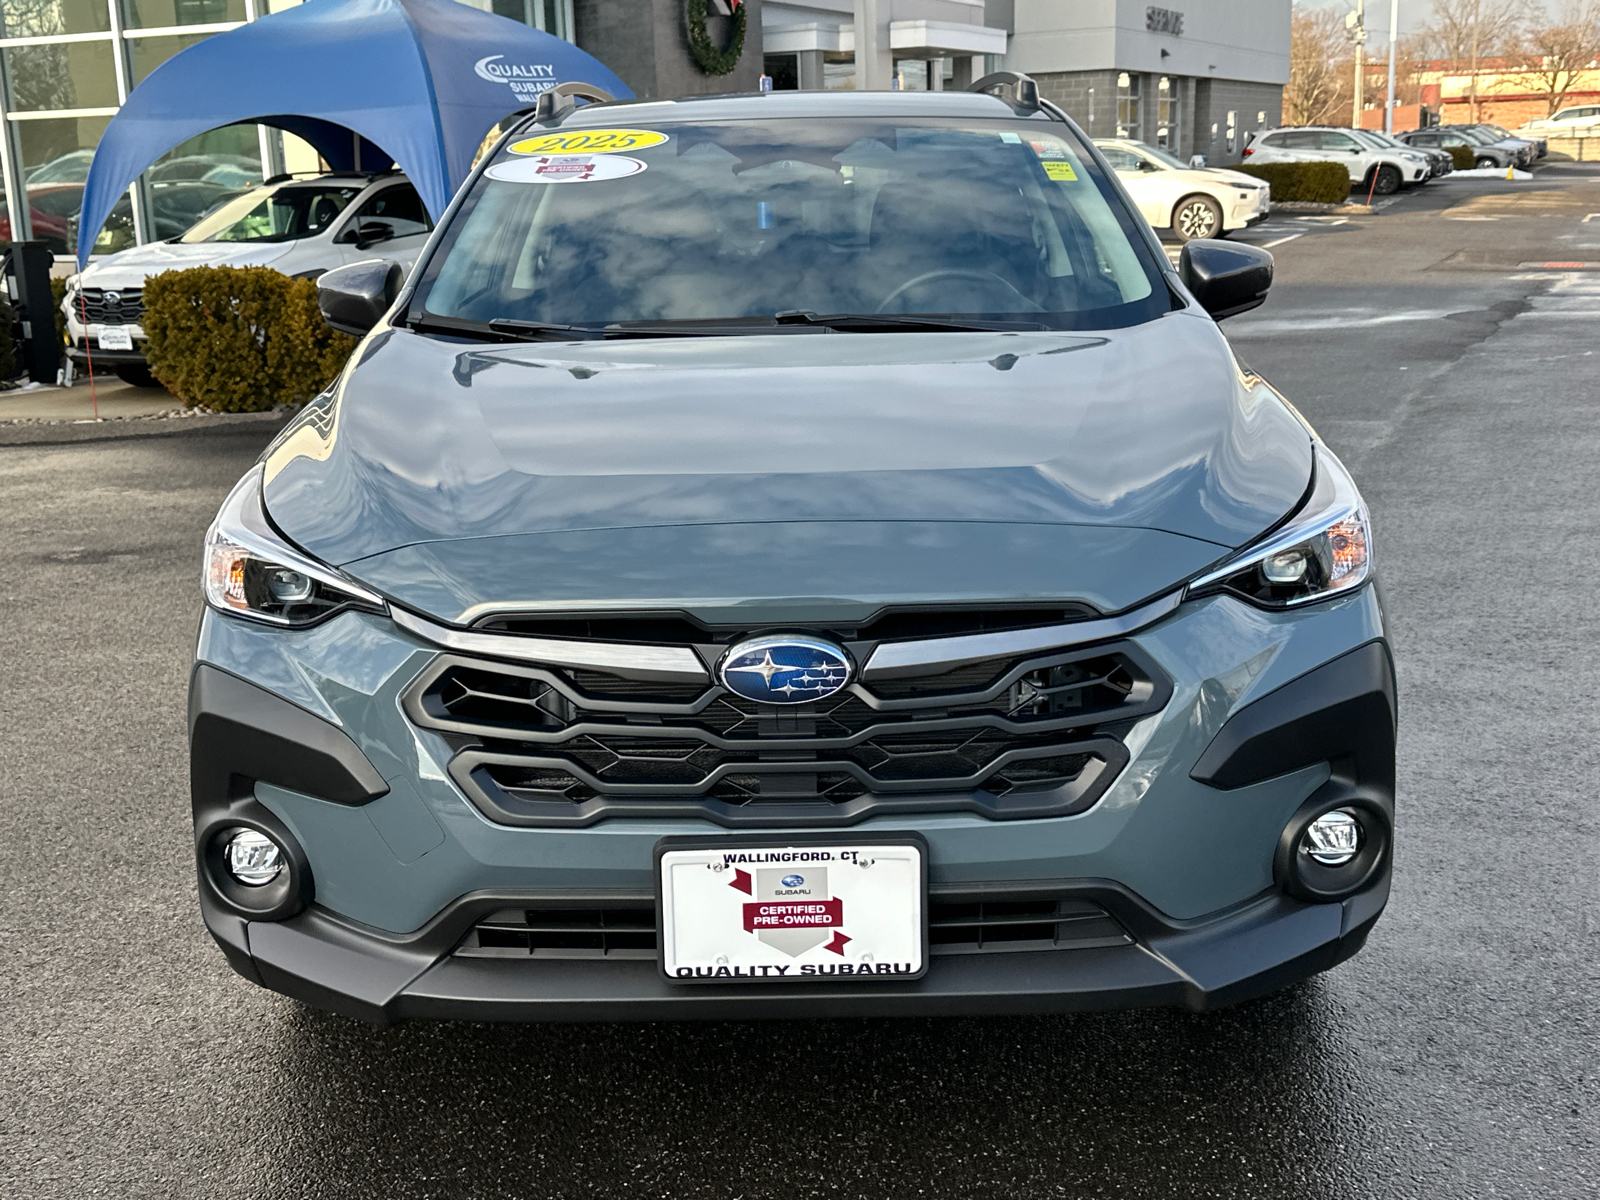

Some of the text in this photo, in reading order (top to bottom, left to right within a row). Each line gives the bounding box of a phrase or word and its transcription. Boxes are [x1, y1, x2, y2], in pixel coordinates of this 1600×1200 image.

[487, 64, 554, 77] QUALITY
[509, 81, 559, 93] SUBAR
[533, 133, 643, 152] 2025
[841, 851, 859, 860] CT
[759, 905, 826, 915] CERTIFIED
[753, 914, 833, 925] PRE-OWNED
[676, 963, 912, 978] QUALITY SUBARU
